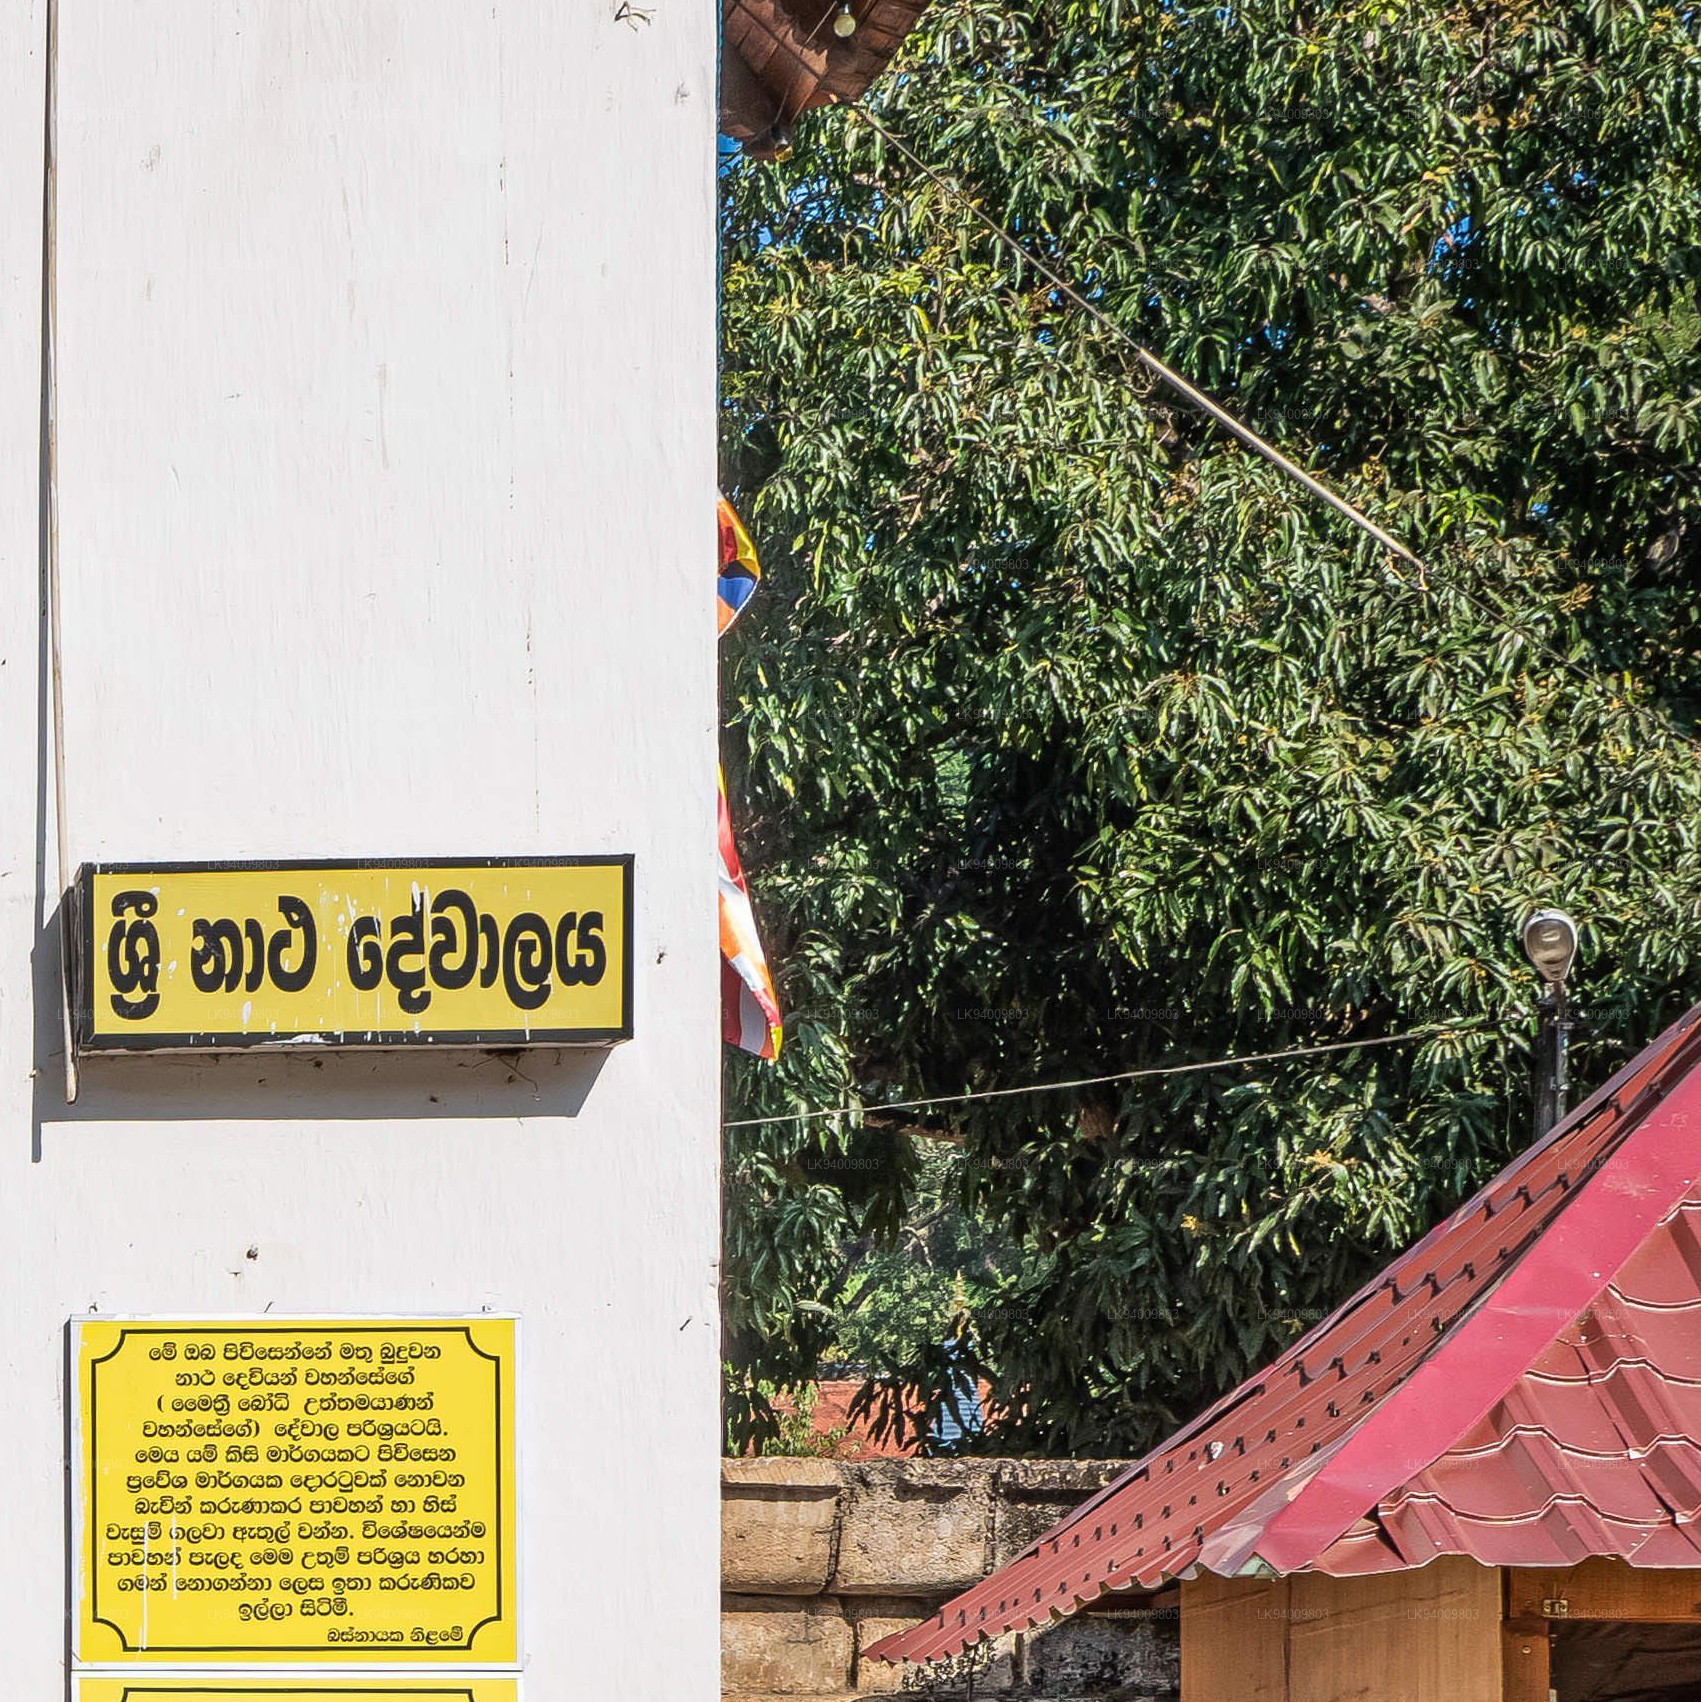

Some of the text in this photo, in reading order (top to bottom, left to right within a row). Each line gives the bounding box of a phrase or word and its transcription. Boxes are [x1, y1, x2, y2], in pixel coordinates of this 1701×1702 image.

[347, 890, 606, 1014] දේවාලය
[149, 1342, 441, 1364] මේ ඔබ පිවිසෙන්නේ මතු බුදුවන
[223, 1367, 297, 1390] දෙවියන්
[305, 1366, 414, 1385] වහන්සේගේ
[238, 1393, 289, 1411] බෝධි
[304, 1392, 433, 1415] උත්තමයාණන්
[135, 1443, 456, 1463] මෙය යම් කිසි මාර්ගයකට පිවිසෙන
[196, 1471, 282, 1488] මාර්ගයක
[291, 1469, 387, 1493] දොරටුවක්
[395, 1471, 464, 1487] නොවන
[135, 1494, 456, 1514] බැවින් කරුණාකර පාවහන් හා හිස්
[328, 1626, 463, 1644] බස්නායක නිළමේ
